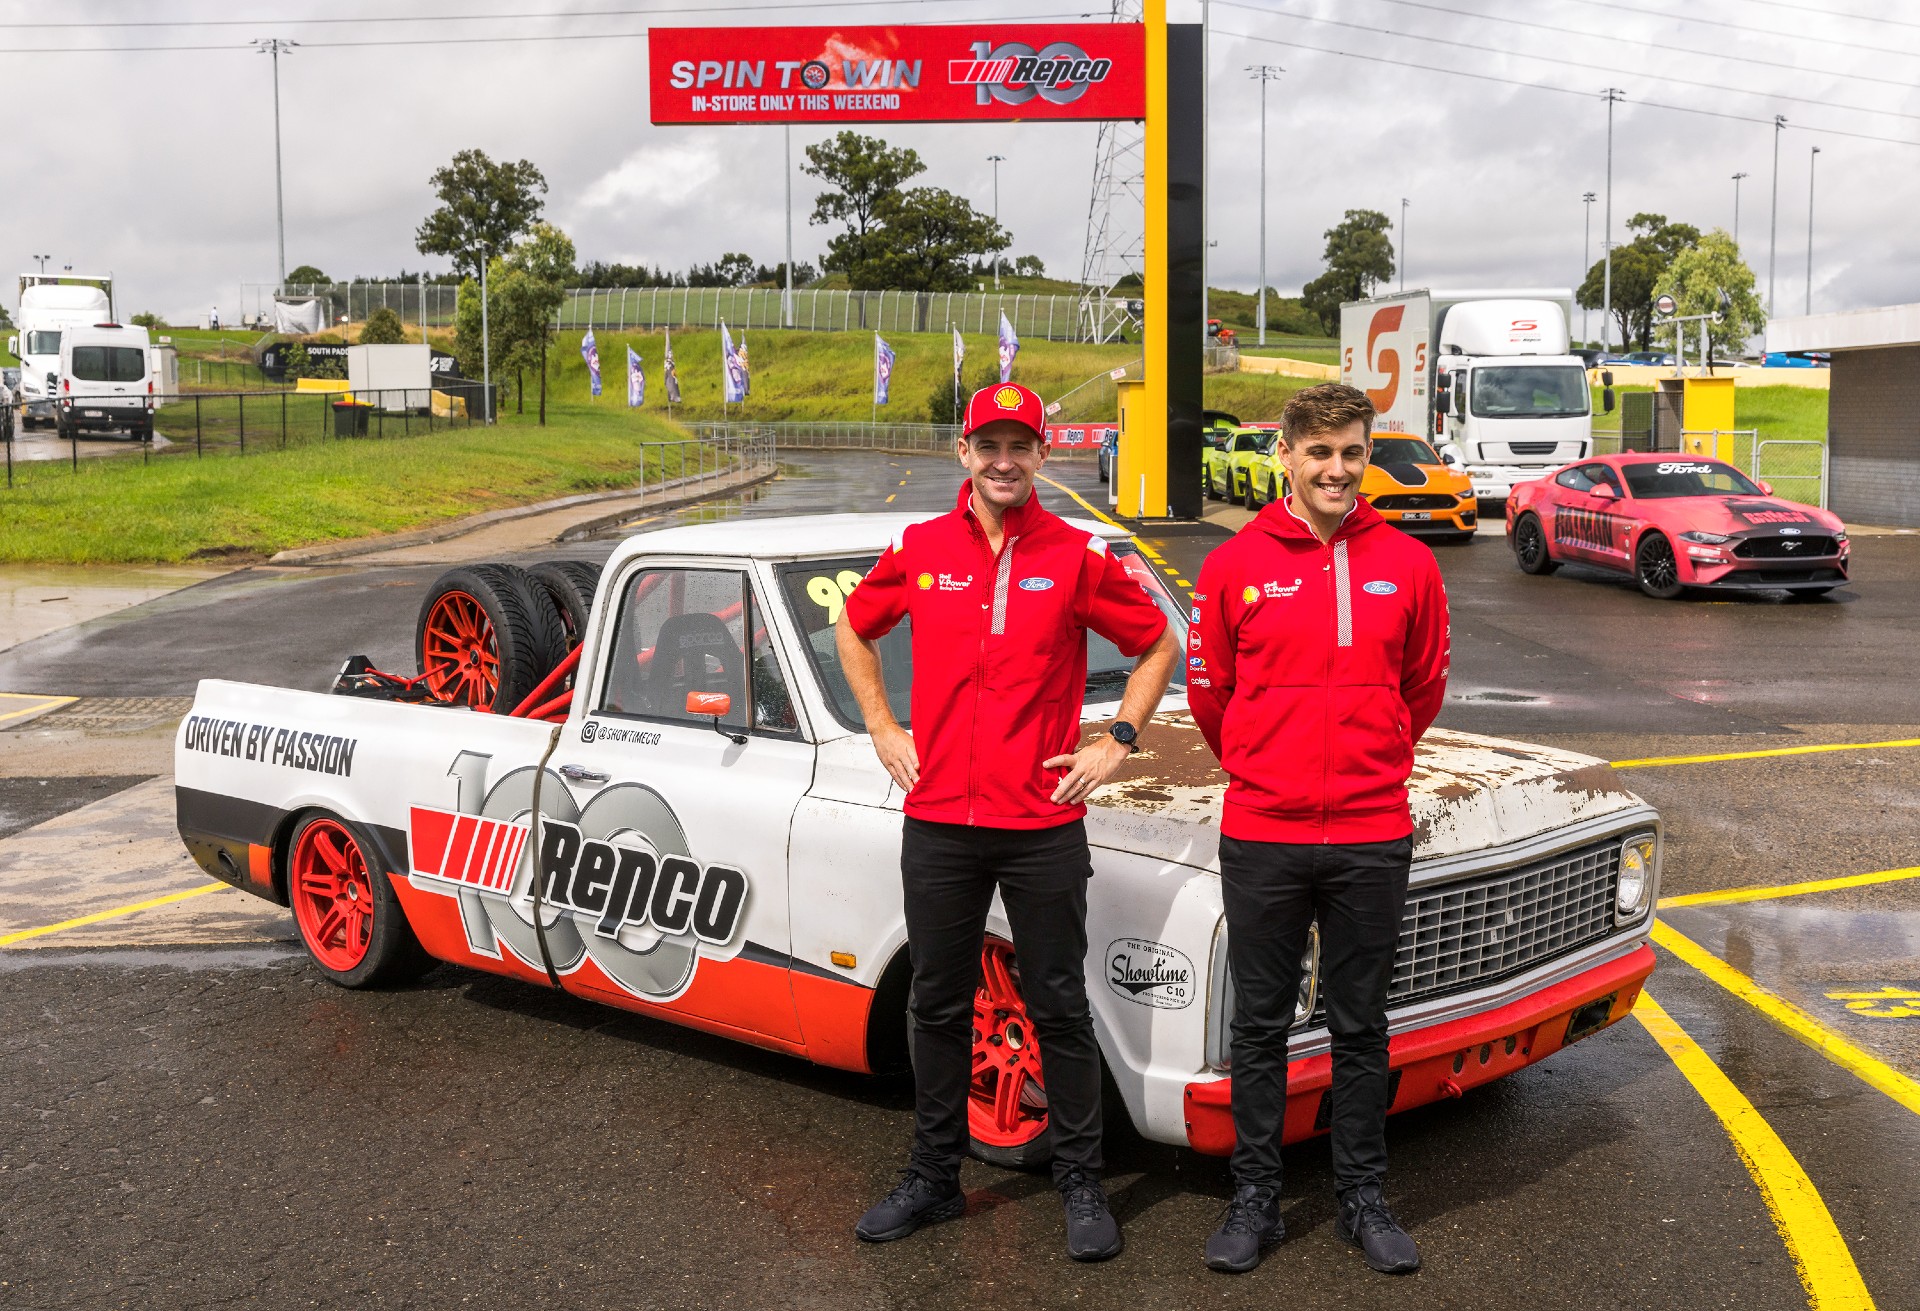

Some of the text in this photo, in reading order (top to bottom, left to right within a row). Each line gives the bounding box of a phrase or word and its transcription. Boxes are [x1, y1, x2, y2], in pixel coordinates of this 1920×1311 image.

[670, 60, 772, 89] SPIN
[842, 59, 922, 88] WIN
[1010, 56, 1112, 88] Repco
[691, 93, 900, 112] IN-STORE ONLY THIS WEEKEND
[307, 347, 349, 356] SOUTH PADD
[1656, 463, 1712, 475] Ford
[939, 579, 970, 587] V-Power
[1025, 578, 1046, 589] Ford
[1264, 585, 1300, 594] V-Power
[1370, 582, 1391, 593] Ford
[1191, 677, 1211, 685] coles
[185, 716, 357, 777] DRIVEN BY PASSION
[525, 817, 747, 944] Repco
[1127, 942, 1175, 959] THE ORIGINAL
[1111, 953, 1189, 983] Showtime
